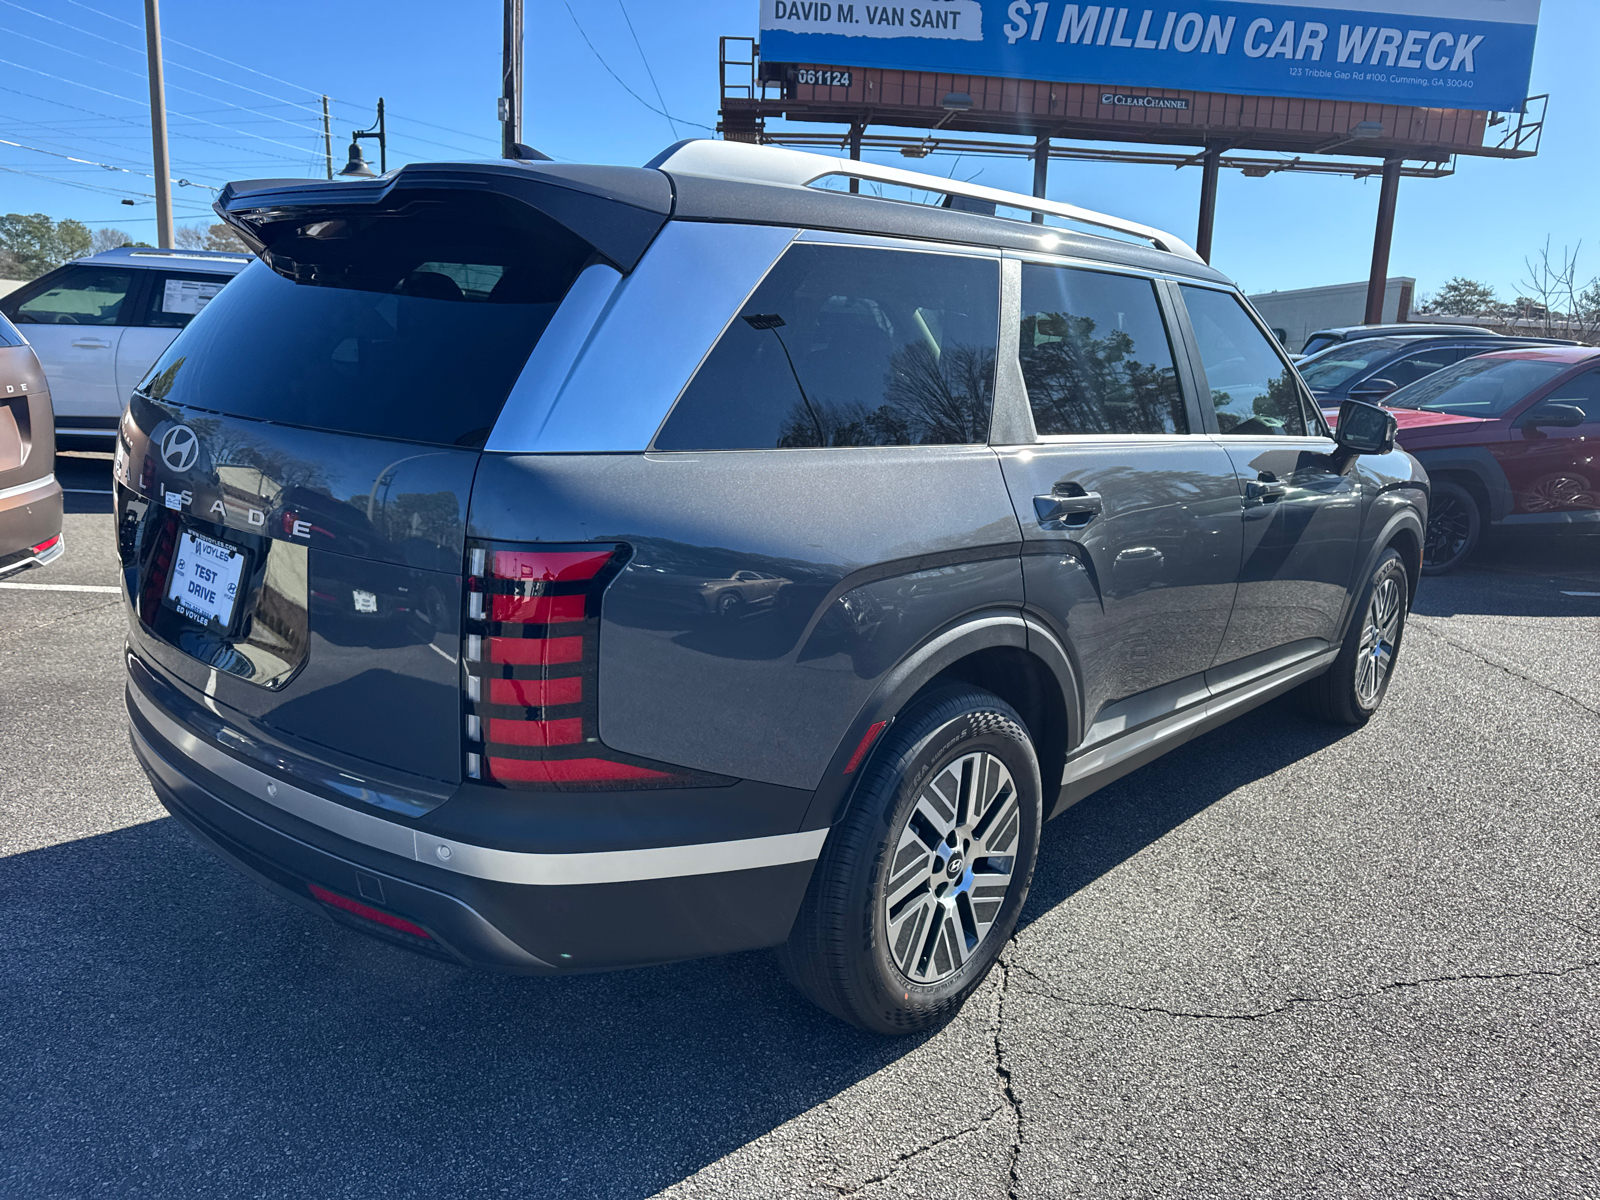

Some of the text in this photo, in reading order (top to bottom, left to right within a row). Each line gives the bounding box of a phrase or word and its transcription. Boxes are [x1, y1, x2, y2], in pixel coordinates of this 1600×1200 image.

[774, 0, 961, 30] DAVID M. VAN SANT
[1003, 0, 1485, 73] $1 MILLION CAR WRECK
[798, 69, 850, 87] 061124
[1289, 67, 1474, 89] 123 Tribble Gap Rd #100, Cumming, GA 30040
[202, 543, 230, 563] VOYLES
[194, 563, 218, 584] TEST
[1374, 559, 1396, 590] NEXEN
[187, 580, 217, 605] DRIVE
[176, 604, 185, 615] ED
[185, 609, 209, 627] VOYLES
